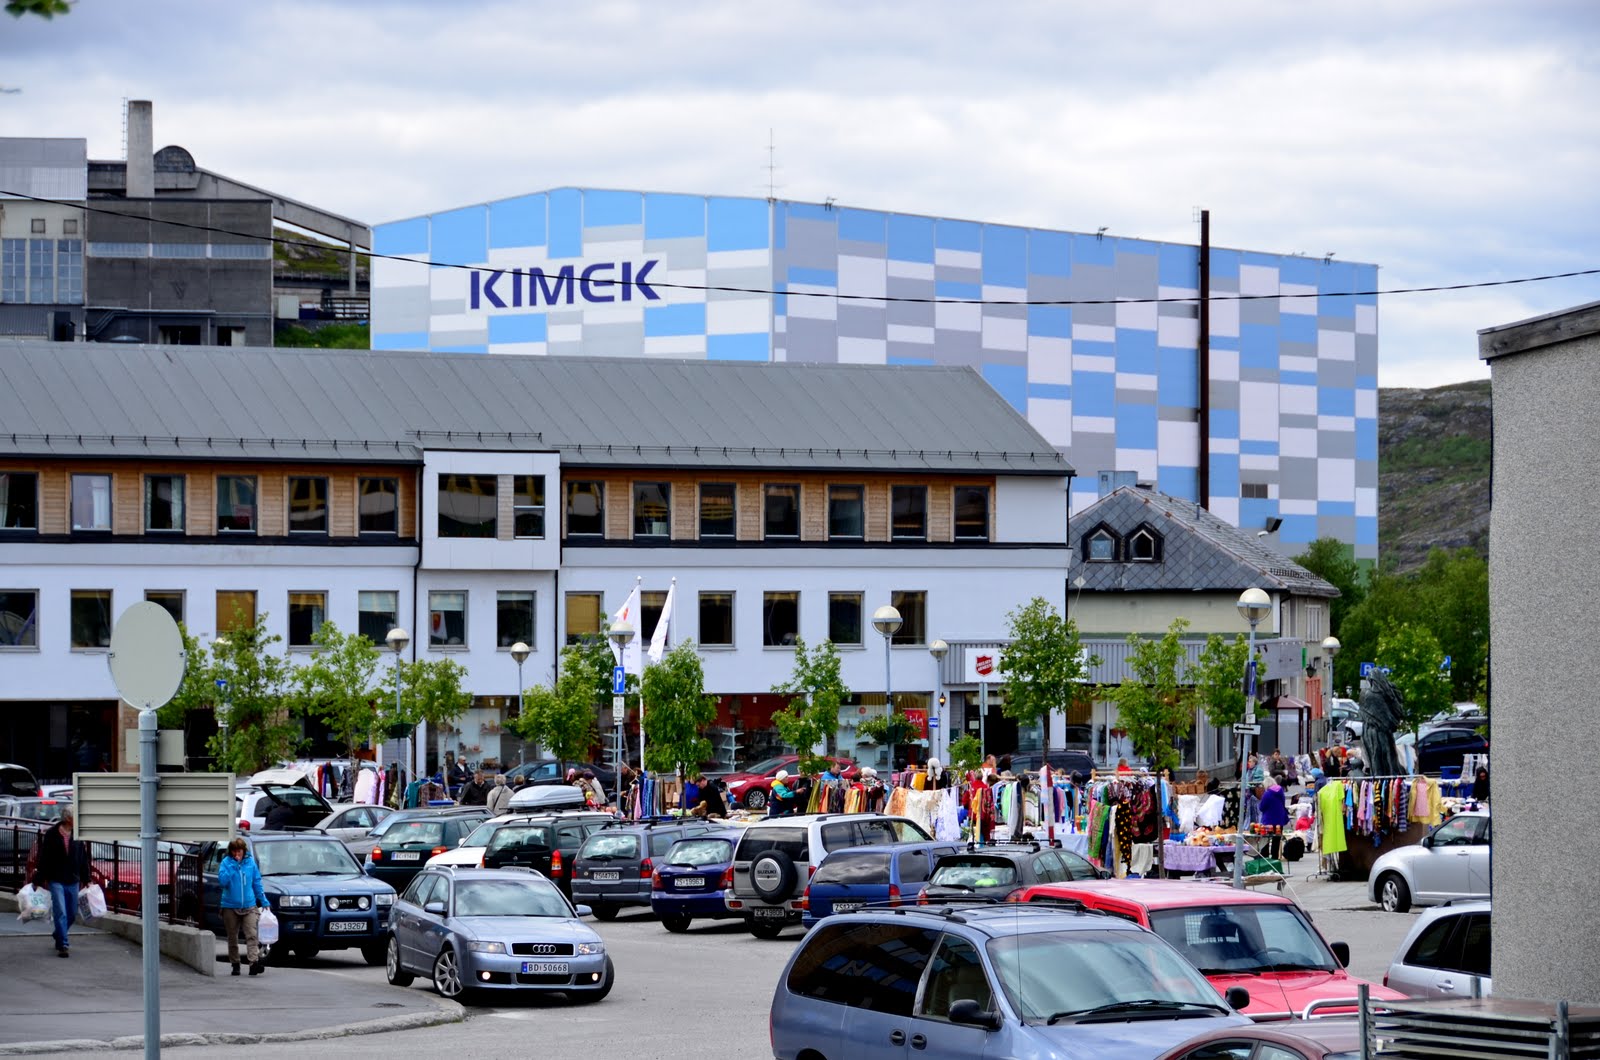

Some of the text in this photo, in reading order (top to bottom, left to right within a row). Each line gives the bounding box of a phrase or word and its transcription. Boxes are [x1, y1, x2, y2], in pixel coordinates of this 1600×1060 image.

[470, 260, 660, 309] KIMEK
[616, 670, 623, 691] P
[343, 922, 365, 930] 19267
[528, 963, 567, 971] BD 50668
